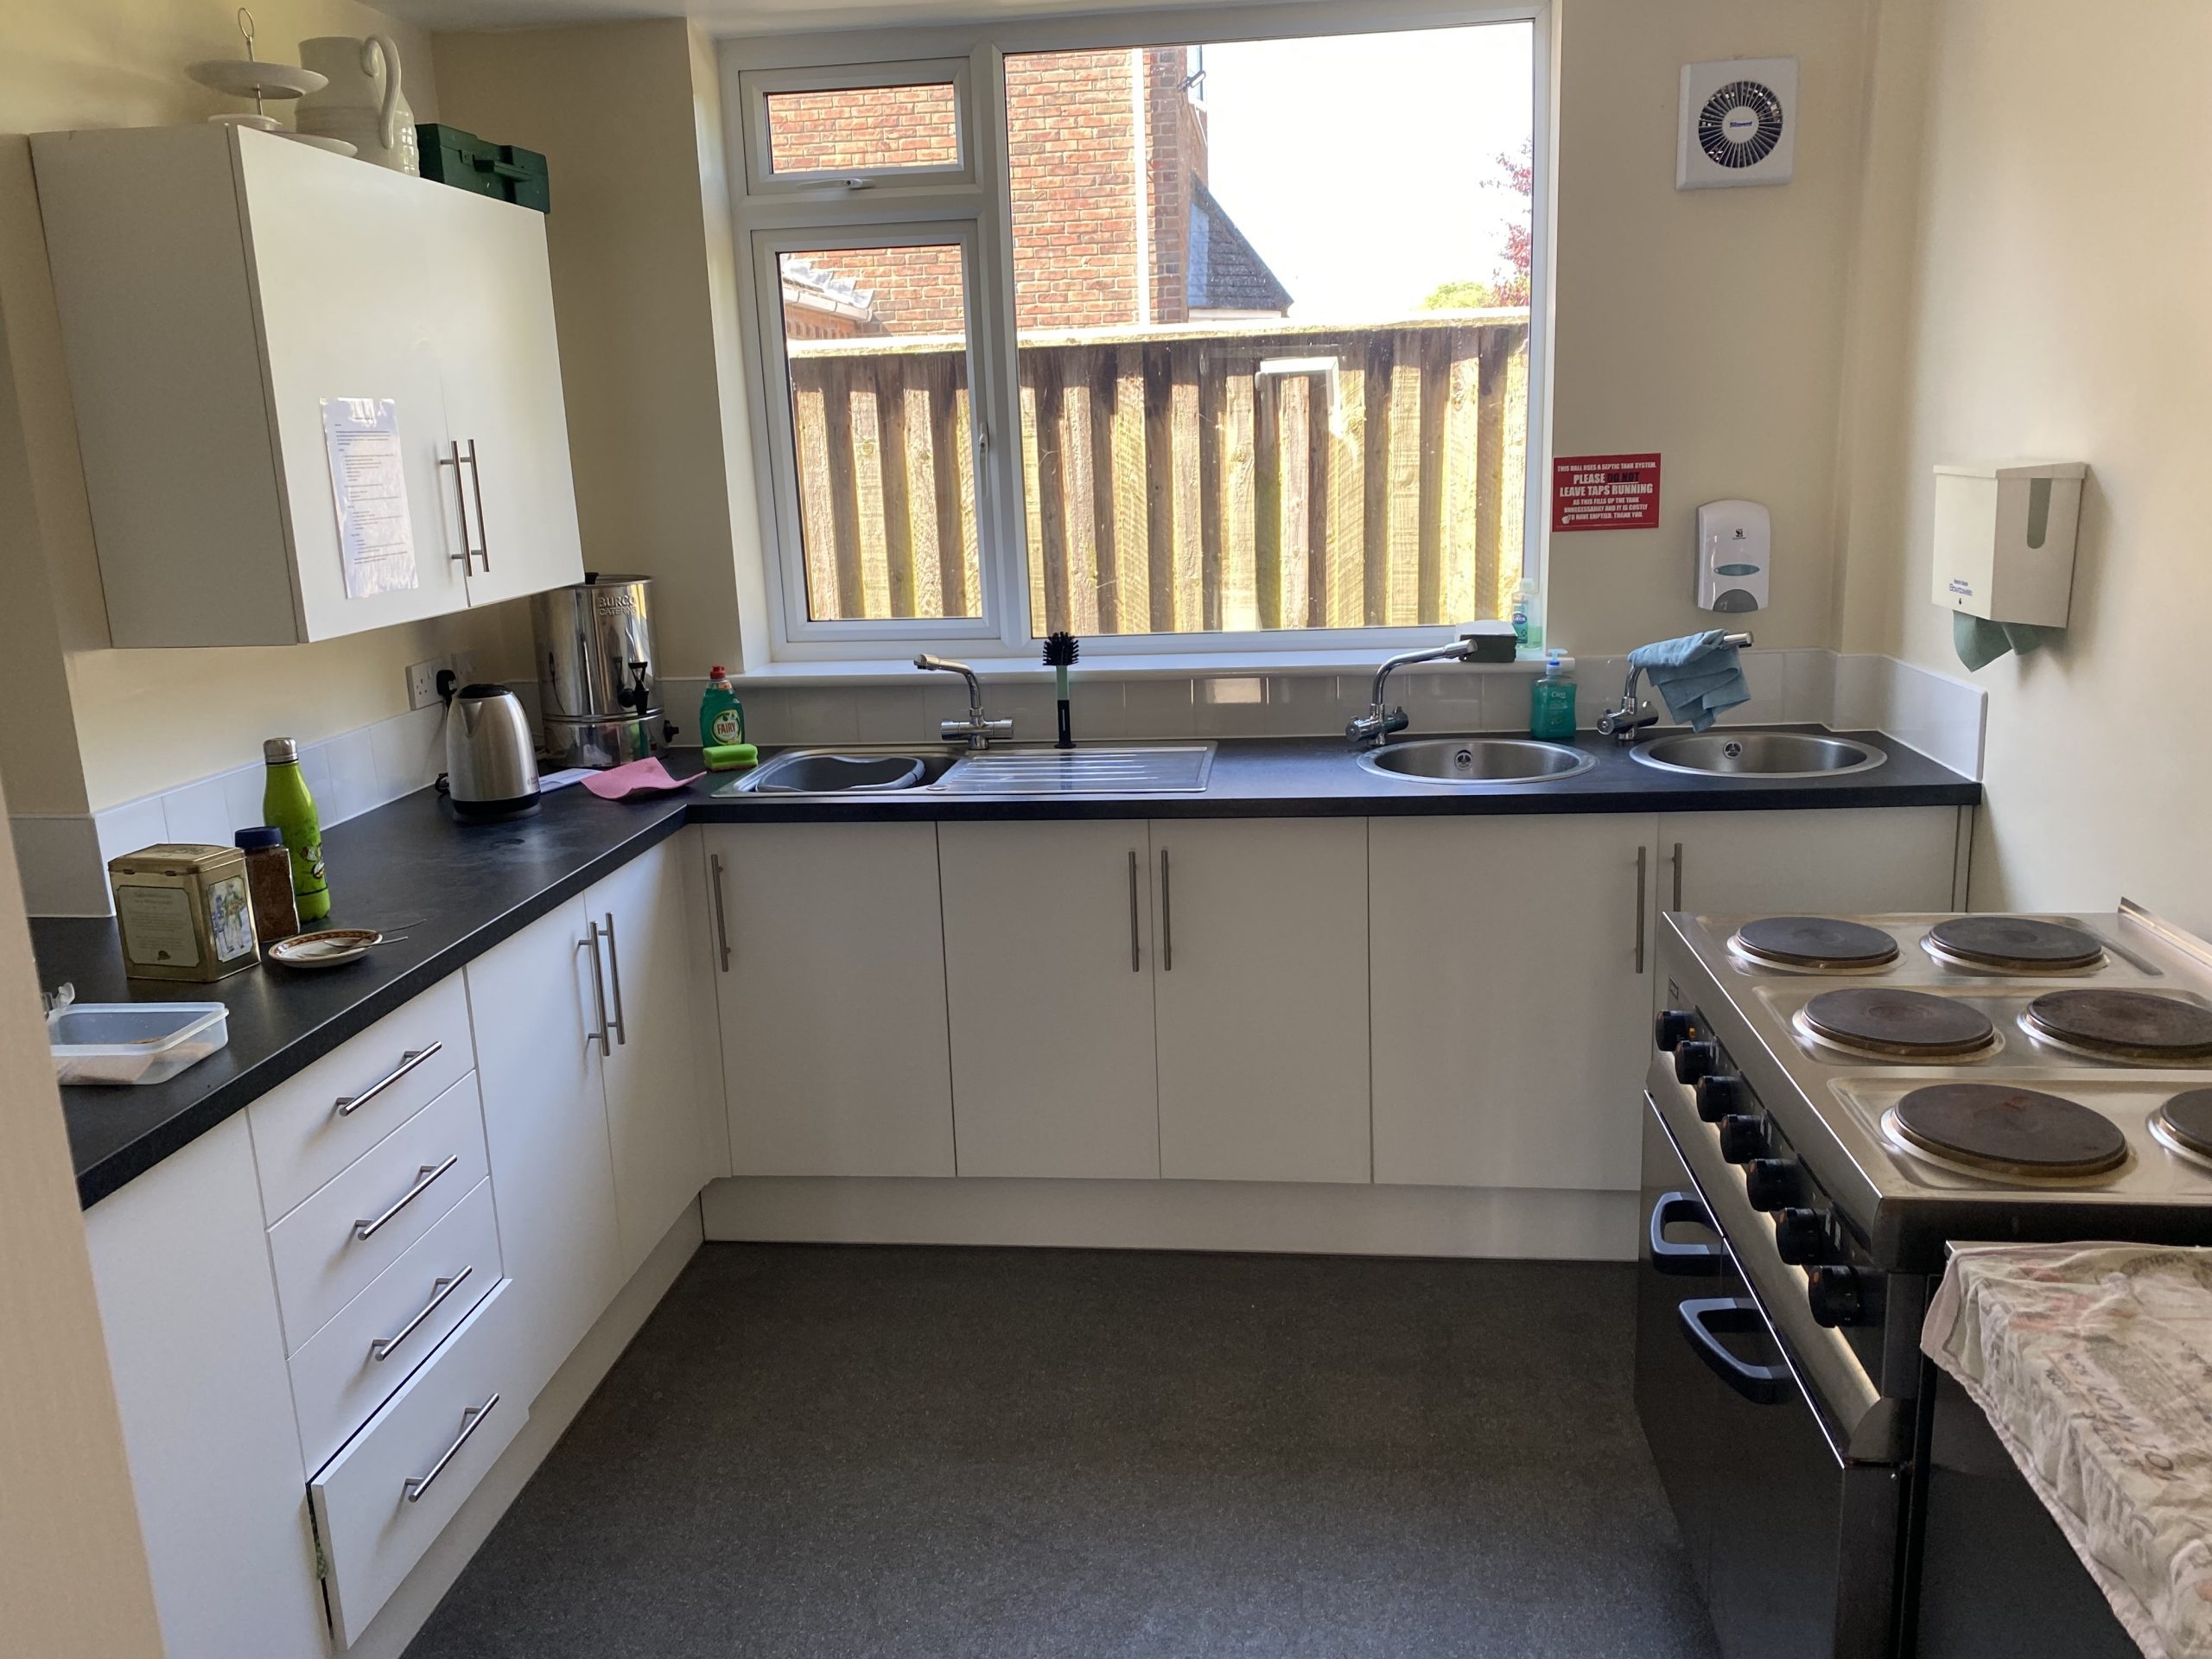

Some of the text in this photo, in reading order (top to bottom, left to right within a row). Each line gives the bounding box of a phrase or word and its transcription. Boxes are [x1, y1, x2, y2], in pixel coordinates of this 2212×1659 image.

[1573, 473, 1605, 485] PLEASE
[1560, 483, 1653, 498] LEAVE TAPS RUNNING
[599, 594, 636, 607] BURCO
[600, 606, 636, 616] CATERING
[717, 722, 735, 734] FAIRY
